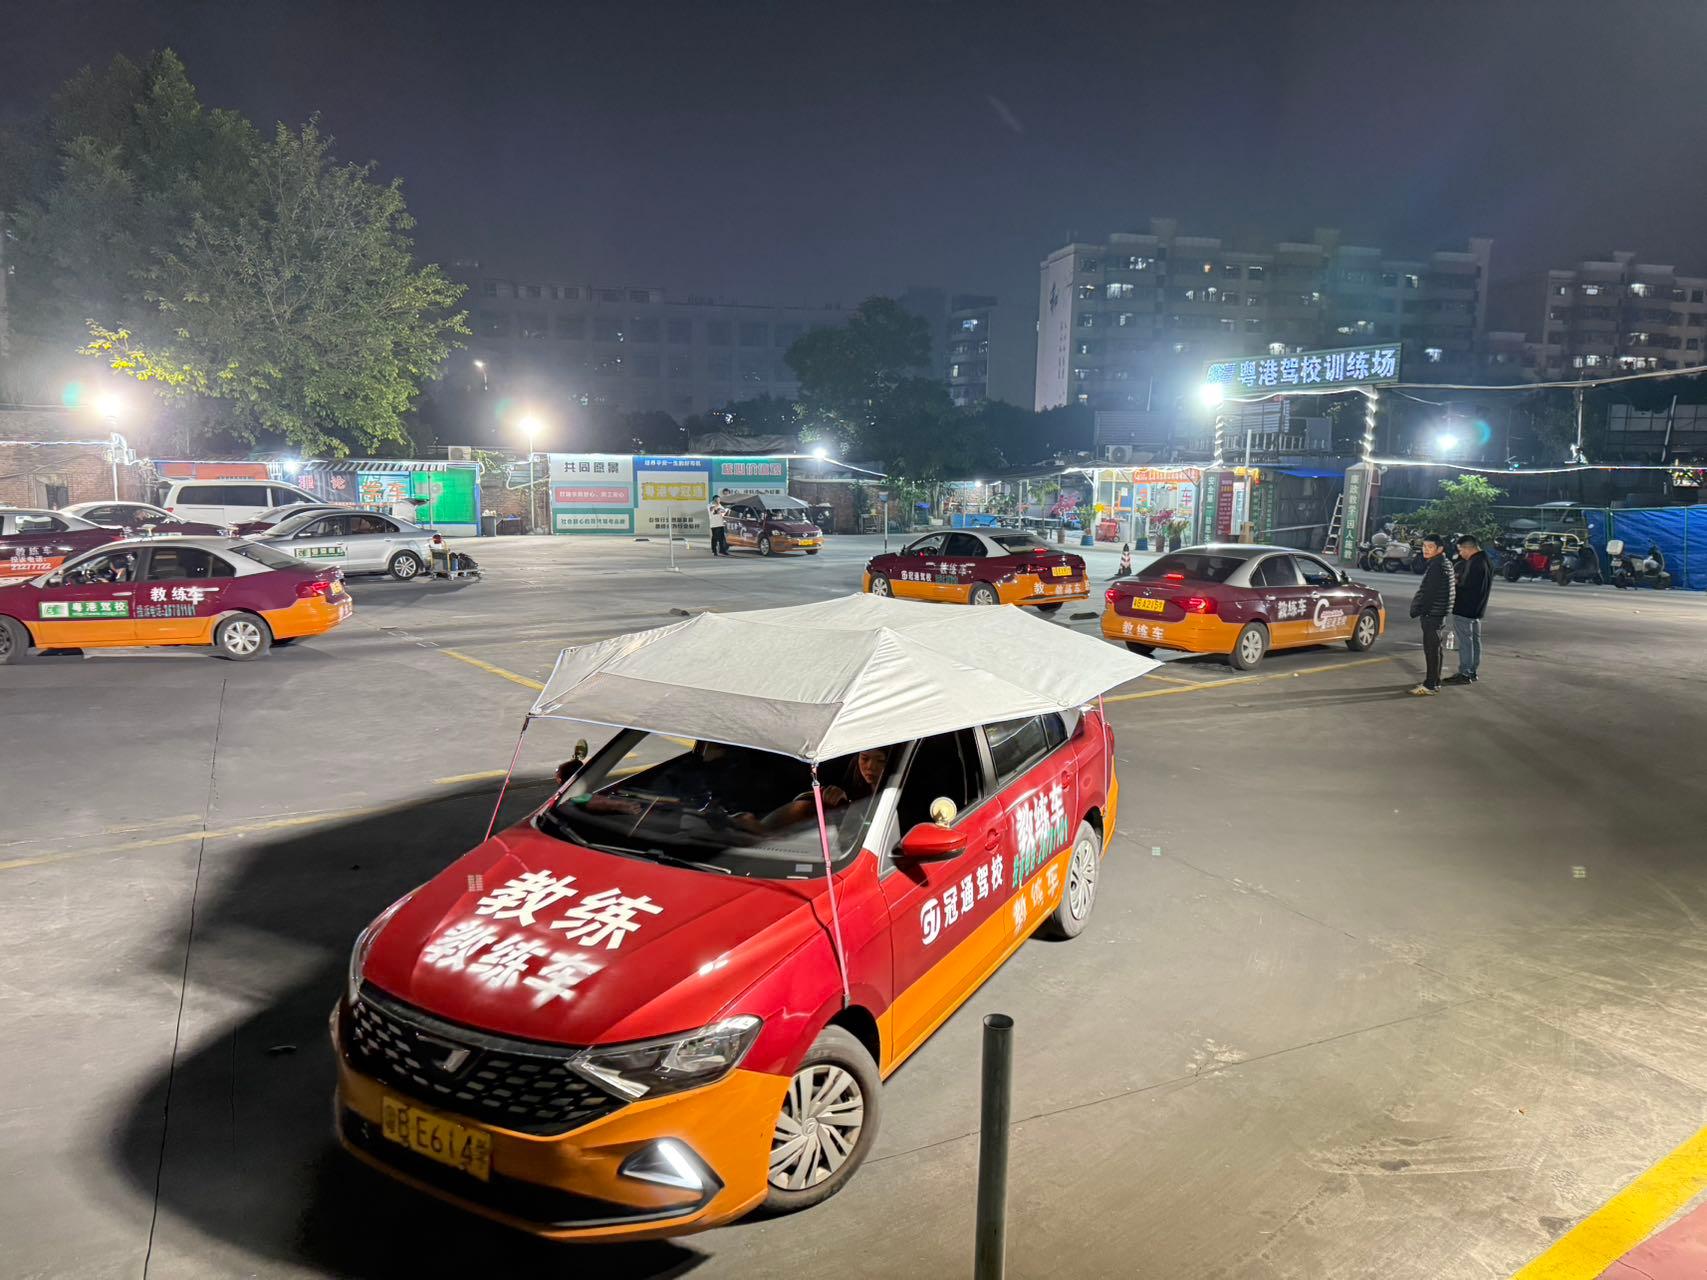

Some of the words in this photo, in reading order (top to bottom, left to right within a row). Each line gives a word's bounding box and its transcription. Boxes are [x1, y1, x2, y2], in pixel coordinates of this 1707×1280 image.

[1239, 349, 1397, 388] 粤港驾校训练场
[564, 461, 620, 473] 共同愿景
[150, 586, 206, 605] 教练车
[1278, 598, 1307, 619] 教练车
[1122, 621, 1164, 640] 教练车
[1014, 783, 1067, 854] 教练车
[475, 868, 664, 956] 教练
[944, 854, 1005, 928] 冠通驾校
[1012, 863, 1063, 937] 教练车
[423, 918, 608, 1010] 教练车
